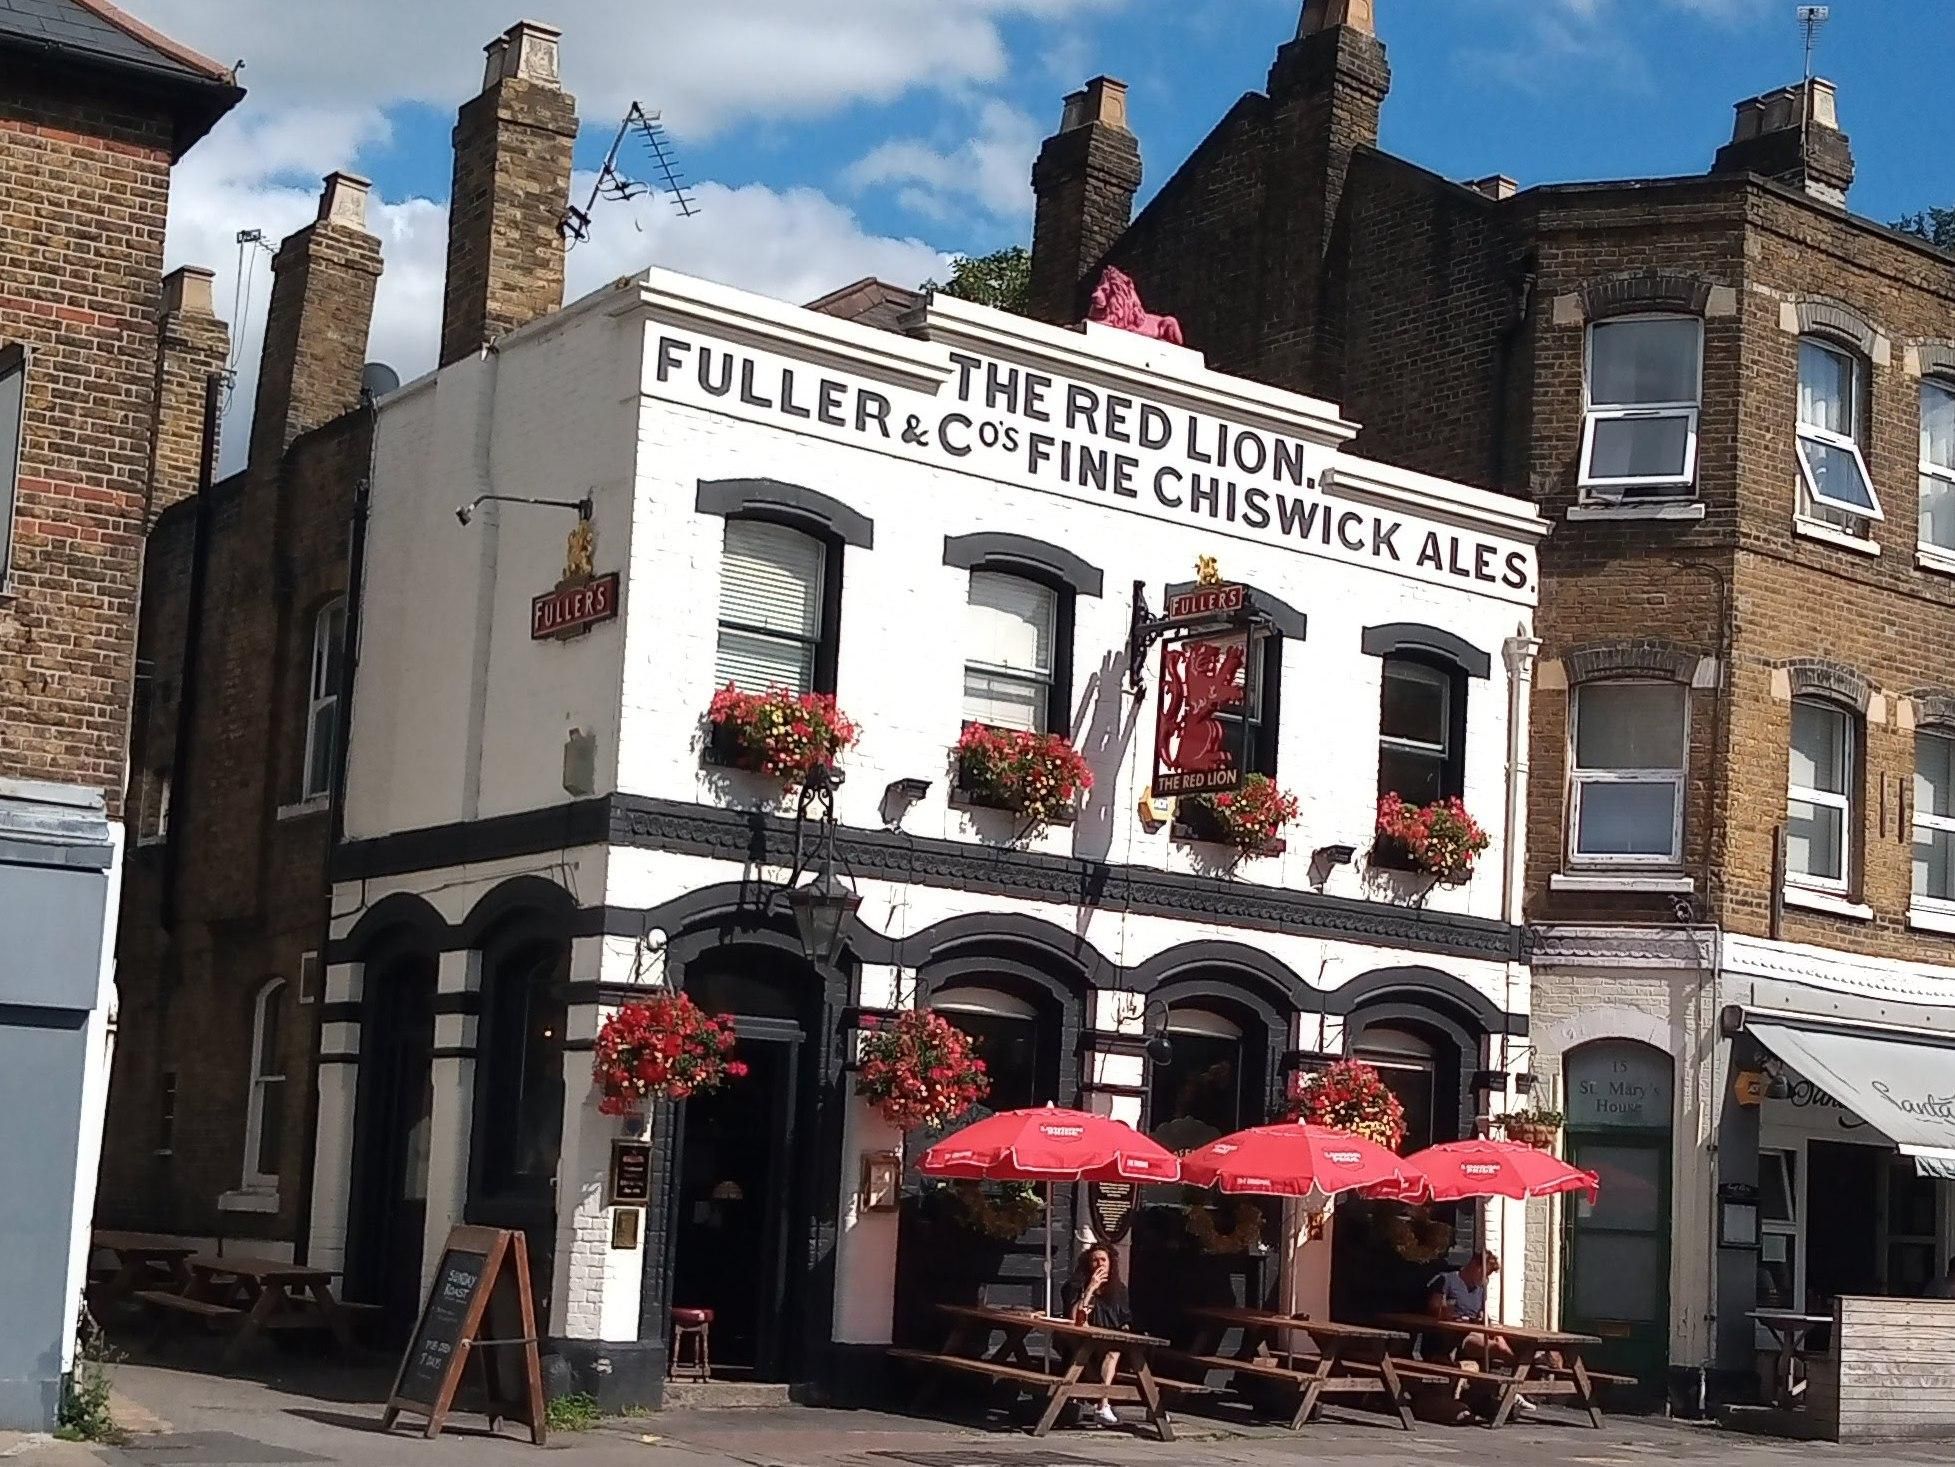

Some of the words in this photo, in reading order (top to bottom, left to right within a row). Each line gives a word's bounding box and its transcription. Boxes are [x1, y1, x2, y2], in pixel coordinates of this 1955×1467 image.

[949, 351, 1052, 423] THE
[1066, 383, 1173, 451] RED
[656, 335, 892, 439] FULLER
[901, 413, 929, 447] &
[1028, 431, 1140, 499] FINE
[1153, 465, 1401, 562] CHISWICK
[1158, 775, 1180, 792] THE
[1183, 772, 1204, 789] RED
[1206, 769, 1237, 787] LION
[1596, 1098, 1643, 1113] House
